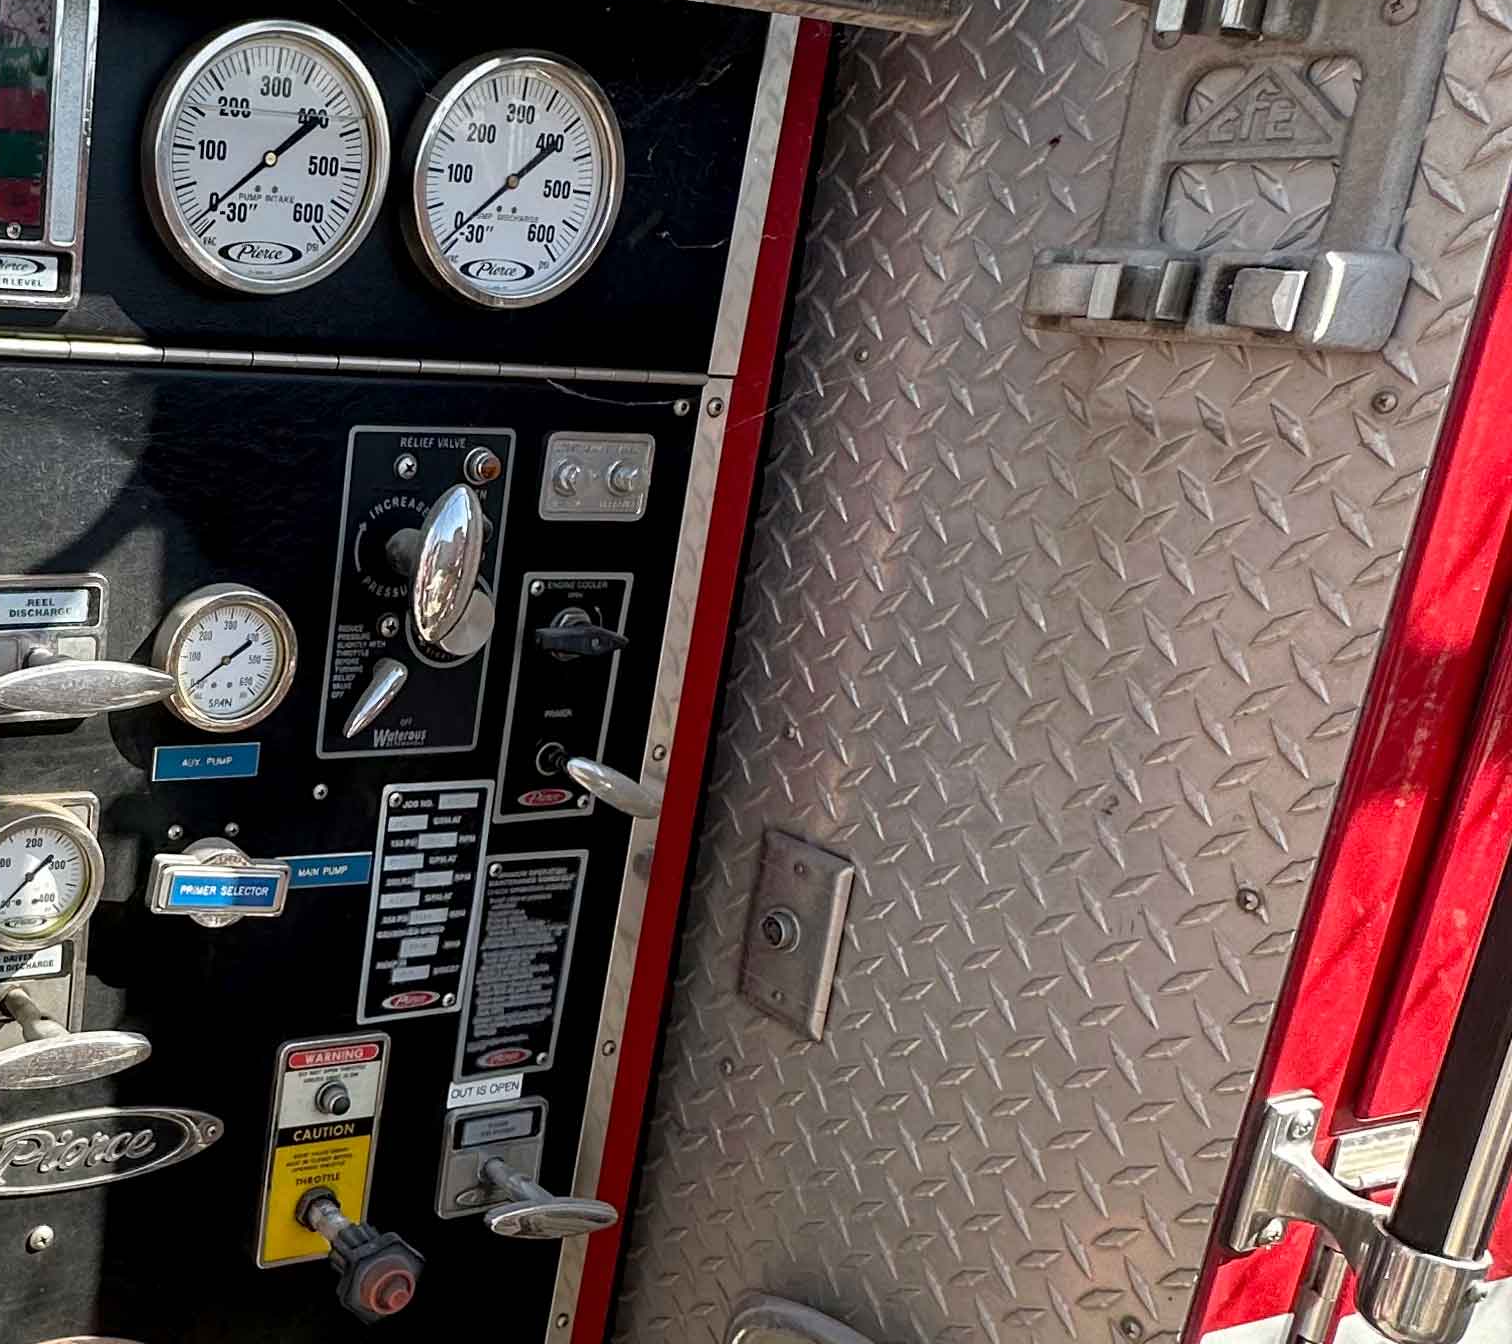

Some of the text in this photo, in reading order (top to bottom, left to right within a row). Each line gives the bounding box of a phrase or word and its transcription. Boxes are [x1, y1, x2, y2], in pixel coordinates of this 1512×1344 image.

[260, 75, 292, 98] 300
[218, 96, 252, 118] 200
[507, 103, 535, 125] 300
[466, 123, 496, 144] 200
[198, 139, 227, 160] 100
[536, 133, 564, 153] 400
[308, 156, 338, 176] 500
[447, 164, 472, 183] 100
[238, 192, 262, 202] PUMP
[543, 180, 571, 199] 500
[209, 192, 218, 211] 0
[293, 204, 323, 223] 600
[527, 223, 555, 243] 600
[237, 243, 283, 262] Pierce
[476, 261, 518, 277] Pierce
[11, 277, 43, 288] LEVEL
[400, 437, 466, 449] RELIEF VALVE
[25, 598, 56, 607] REEL
[8, 607, 72, 618] DISCHARGE
[224, 620, 237, 630] 300
[200, 631, 212, 640] 200
[248, 656, 261, 664] 500
[209, 698, 232, 708] SPAN
[374, 728, 426, 747] Waterous
[182, 757, 232, 767] AUX PUMP
[25, 838, 43, 848] 200
[49, 860, 66, 870] 300
[298, 866, 348, 877] MAIN PUMP
[180, 885, 269, 896] PRIMER SELECTOR
[305, 1048, 364, 1064] WARNING
[451, 1080, 519, 1099] OUT IS OPEN
[293, 1123, 355, 1142] CAUTION
[296, 1172, 340, 1186] THROTTLE
